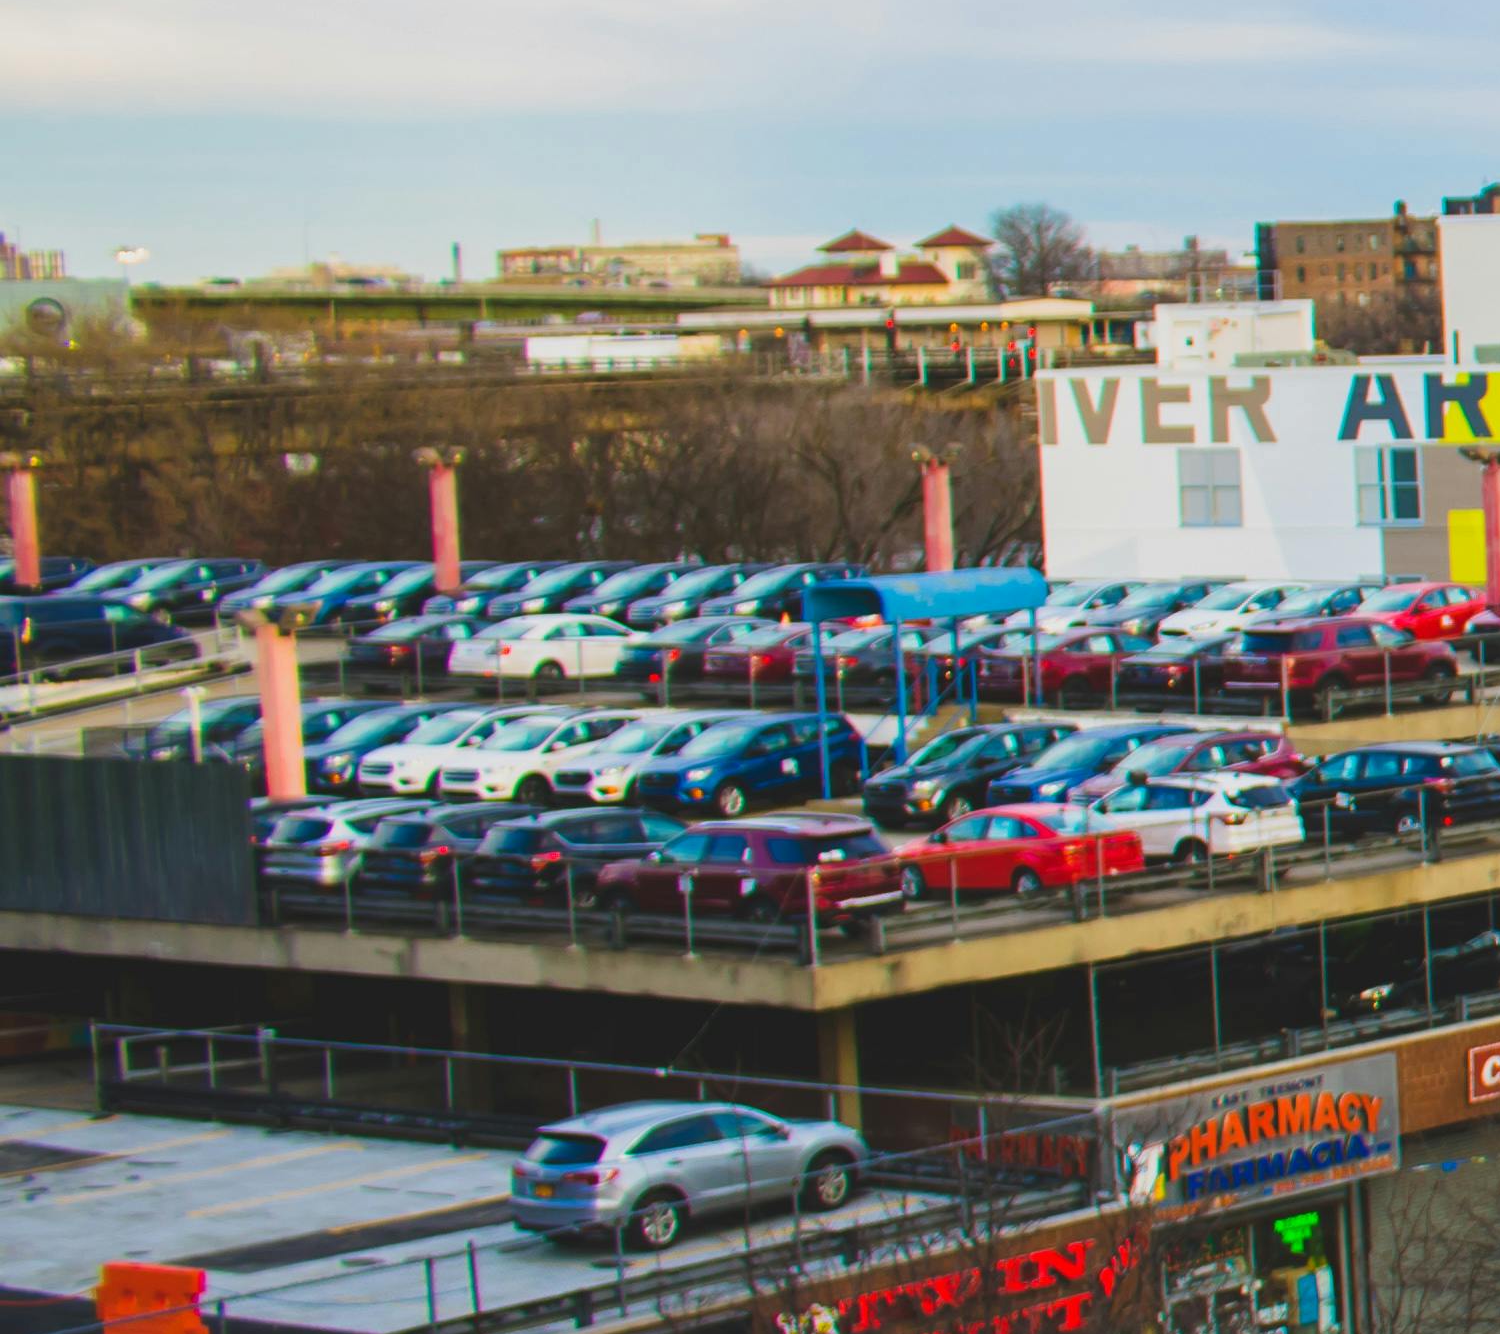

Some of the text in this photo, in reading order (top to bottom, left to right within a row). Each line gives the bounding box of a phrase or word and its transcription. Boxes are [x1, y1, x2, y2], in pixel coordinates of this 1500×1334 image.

[1212, 1074, 1324, 1109] EAST TREMONT
[1168, 1091, 1384, 1181] PHARMACY
[1187, 1133, 1370, 1199] FARMACIA
[838, 1238, 1096, 1334] TWIN
